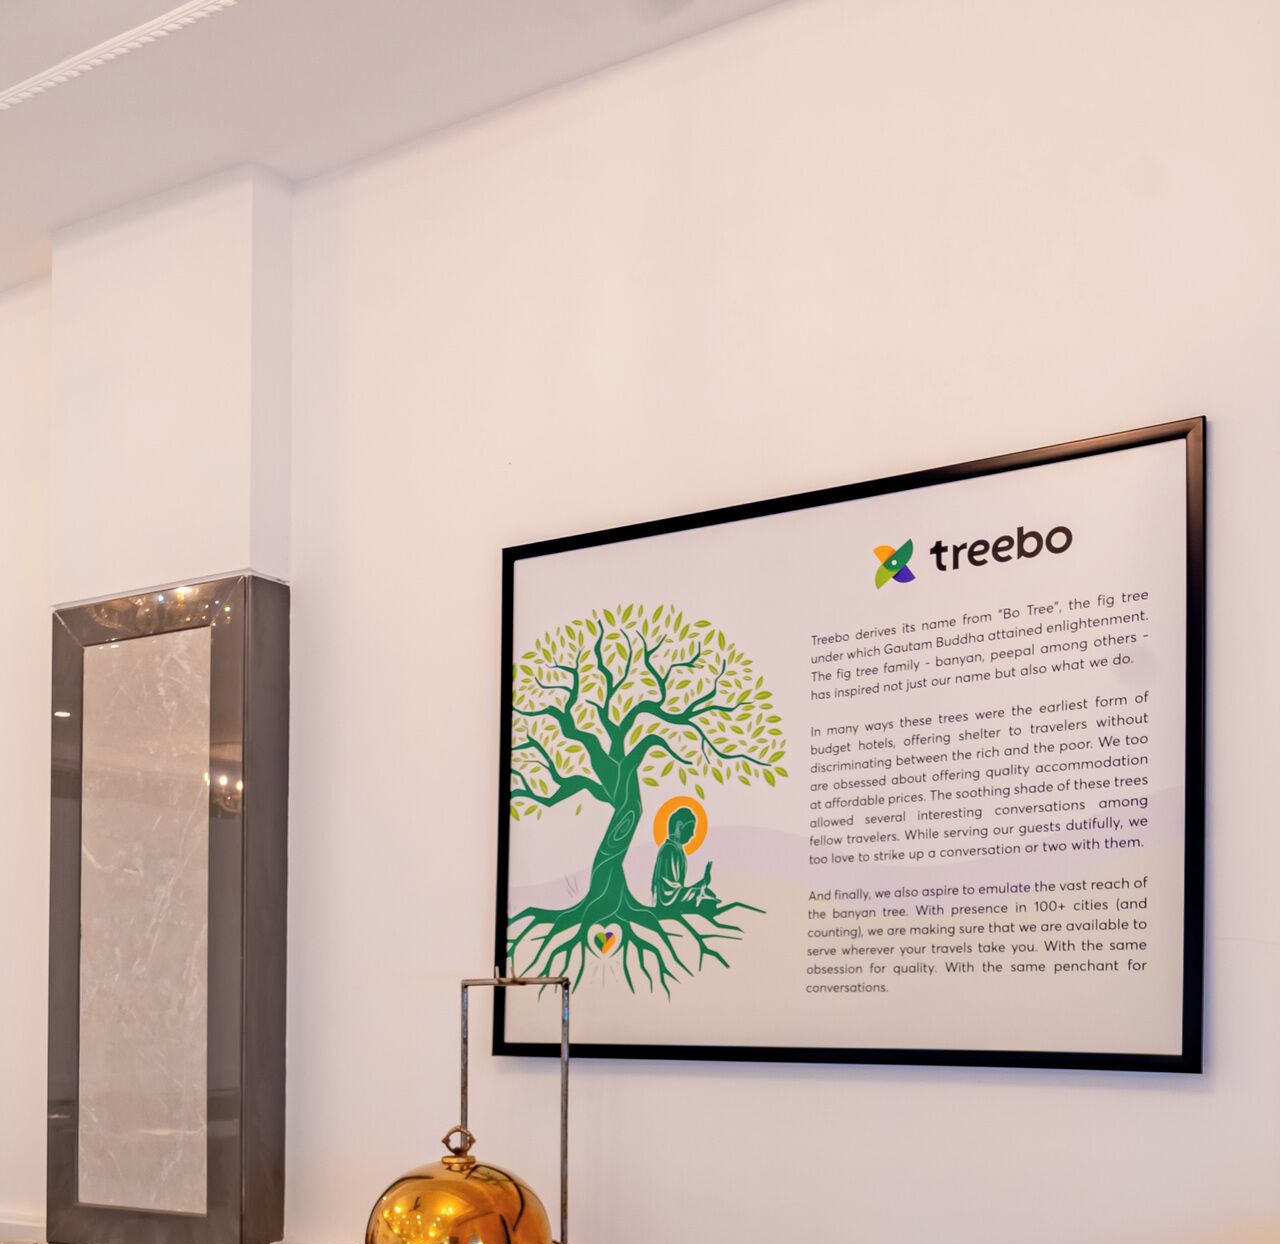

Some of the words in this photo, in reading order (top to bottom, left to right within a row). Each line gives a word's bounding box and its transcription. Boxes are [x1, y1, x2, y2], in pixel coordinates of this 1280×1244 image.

[930, 526, 1073, 571] treebo
[810, 632, 850, 646] Treebo
[854, 626, 896, 640] derives
[902, 623, 916, 634] its
[921, 618, 956, 631] name
[962, 613, 992, 625] from
[1068, 597, 1090, 610] the
[1097, 594, 1114, 608] fig
[1121, 591, 1148, 603] tree
[810, 651, 844, 664] under
[846, 645, 881, 659] which
[883, 640, 932, 654] Gautam
[935, 632, 984, 648] Buddha
[987, 622, 1042, 641] attained
[1046, 610, 1148, 633] enlightenment.
[810, 670, 832, 682] The
[836, 668, 851, 681] fig
[855, 666, 879, 677] tree
[883, 659, 920, 673] family
[935, 653, 984, 667] banyan,
[990, 643, 1034, 663] peepal
[1039, 640, 1088, 654] among
[1092, 633, 1137, 647] others
[810, 689, 831, 700] has
[834, 682, 880, 699] inspired
[883, 680, 903, 692] not
[905, 677, 928, 692] just
[930, 676, 952, 686] our
[954, 671, 991, 684] name
[994, 666, 1016, 679] but
[1019, 663, 1047, 676] also
[1050, 658, 1085, 672] what
[1089, 657, 1108, 668] we
[1112, 652, 1134, 665] do.
[810, 726, 821, 736] In
[826, 724, 859, 735] many
[864, 721, 894, 732] ways
[899, 716, 932, 728] these
[938, 713, 968, 724] trees
[974, 709, 1005, 720] were
[1011, 704, 1032, 716] the
[1039, 698, 1088, 714] earliest
[1095, 695, 1127, 708] form
[1134, 689, 1151, 704] of
[810, 742, 851, 756] budget
[858, 737, 896, 751] hotels,
[903, 733, 950, 746] offering
[958, 727, 1001, 741] shelter
[1008, 725, 1022, 736] to
[1030, 719, 1087, 734] travelers
[1095, 712, 1149, 728] without
[809, 757, 892, 773] discriminating
[895, 753, 948, 766] between
[951, 749, 972, 761] the
[976, 745, 1000, 759] rich
[1003, 742, 1029, 756] and
[1033, 741, 1055, 754] the
[1059, 740, 1093, 754] poor.
[1097, 735, 1120, 748] We
[1125, 734, 1148, 745] too
[809, 782, 828, 792] are
[832, 774, 886, 790] obsessed
[890, 772, 927, 785] about
[931, 768, 980, 782] offering
[985, 763, 1030, 780] quality
[1034, 754, 1148, 773] accommodation
[809, 799, 822, 810] at
[824, 794, 885, 809] affordable
[887, 792, 926, 806] prices.
[929, 789, 952, 801] The
[955, 785, 1010, 799] soothing
[1013, 780, 1054, 795] shade
[1056, 778, 1071, 792] of
[1073, 778, 1110, 790] these
[1114, 776, 1148, 787] trees
[809, 814, 854, 828] allowed
[864, 810, 906, 824] several
[917, 807, 982, 821] interesting
[994, 800, 1086, 815] conversations
[1098, 797, 1148, 809] among
[809, 834, 842, 846] fellow
[846, 831, 900, 844] travelers.
[904, 827, 939, 840] While
[943, 826, 988, 839] serving
[992, 825, 1014, 835] our
[1018, 821, 1060, 836] guests
[1065, 815, 1123, 831] dutifully,
[1128, 817, 1148, 827] we
[809, 855, 828, 864] too
[831, 852, 854, 863] love
[858, 852, 870, 862] to
[873, 849, 905, 861] strike
[908, 850, 924, 861] up
[927, 849, 936, 858] a
[939, 843, 1021, 857] conversation
[1024, 844, 1039, 853] or
[1042, 841, 1067, 852] two
[1071, 837, 1100, 850] with
[1104, 836, 1144, 849] them.
[808, 889, 831, 901] And
[834, 888, 871, 901] finally,
[874, 890, 891, 898] we
[893, 886, 918, 898] also
[921, 885, 959, 899] aspire
[962, 884, 975, 895] to
[978, 881, 1031, 894] emulate
[1034, 880, 1056, 892] the
[1059, 879, 1087, 891] vast
[1090, 876, 1130, 890] reach
[1133, 875, 1148, 888] of
[807, 908, 826, 919] the
[832, 908, 876, 920] banyan
[882, 907, 908, 917] tree.
[915, 903, 944, 915] With
[950, 904, 1008, 917] presence
[1015, 901, 1026, 913] in
[1033, 900, 1066, 912] 100+
[1073, 899, 1108, 911] cities
[1115, 896, 1147, 912] (and
[807, 925, 863, 939] counting),
[867, 928, 884, 936] we
[886, 927, 906, 935] are
[909, 923, 955, 937] making
[958, 925, 985, 934] sure
[988, 921, 1015, 933] that
[1018, 923, 1037, 932] we
[1040, 922, 1062, 932] are
[1065, 917, 1129, 931] available
[1133, 918, 1147, 930] to
[807, 947, 836, 956] serve
[841, 944, 895, 955] wherever
[899, 946, 926, 957] your
[931, 941, 972, 954] travels
[977, 941, 1006, 953] take
[1010, 943, 1038, 955] you.
[1043, 939, 1075, 952] With
[1081, 939, 1103, 951] the
[1109, 941, 1147, 951] same
[806, 964, 862, 975] obsession
[869, 962, 886, 974] for
[892, 962, 937, 976] quality.
[944, 961, 974, 973] With
[982, 960, 1003, 972] the
[1010, 963, 1046, 972] same
[1053, 959, 1119, 974] penchant
[1127, 958, 1148, 971] for
[805, 982, 888, 993] conversations.
